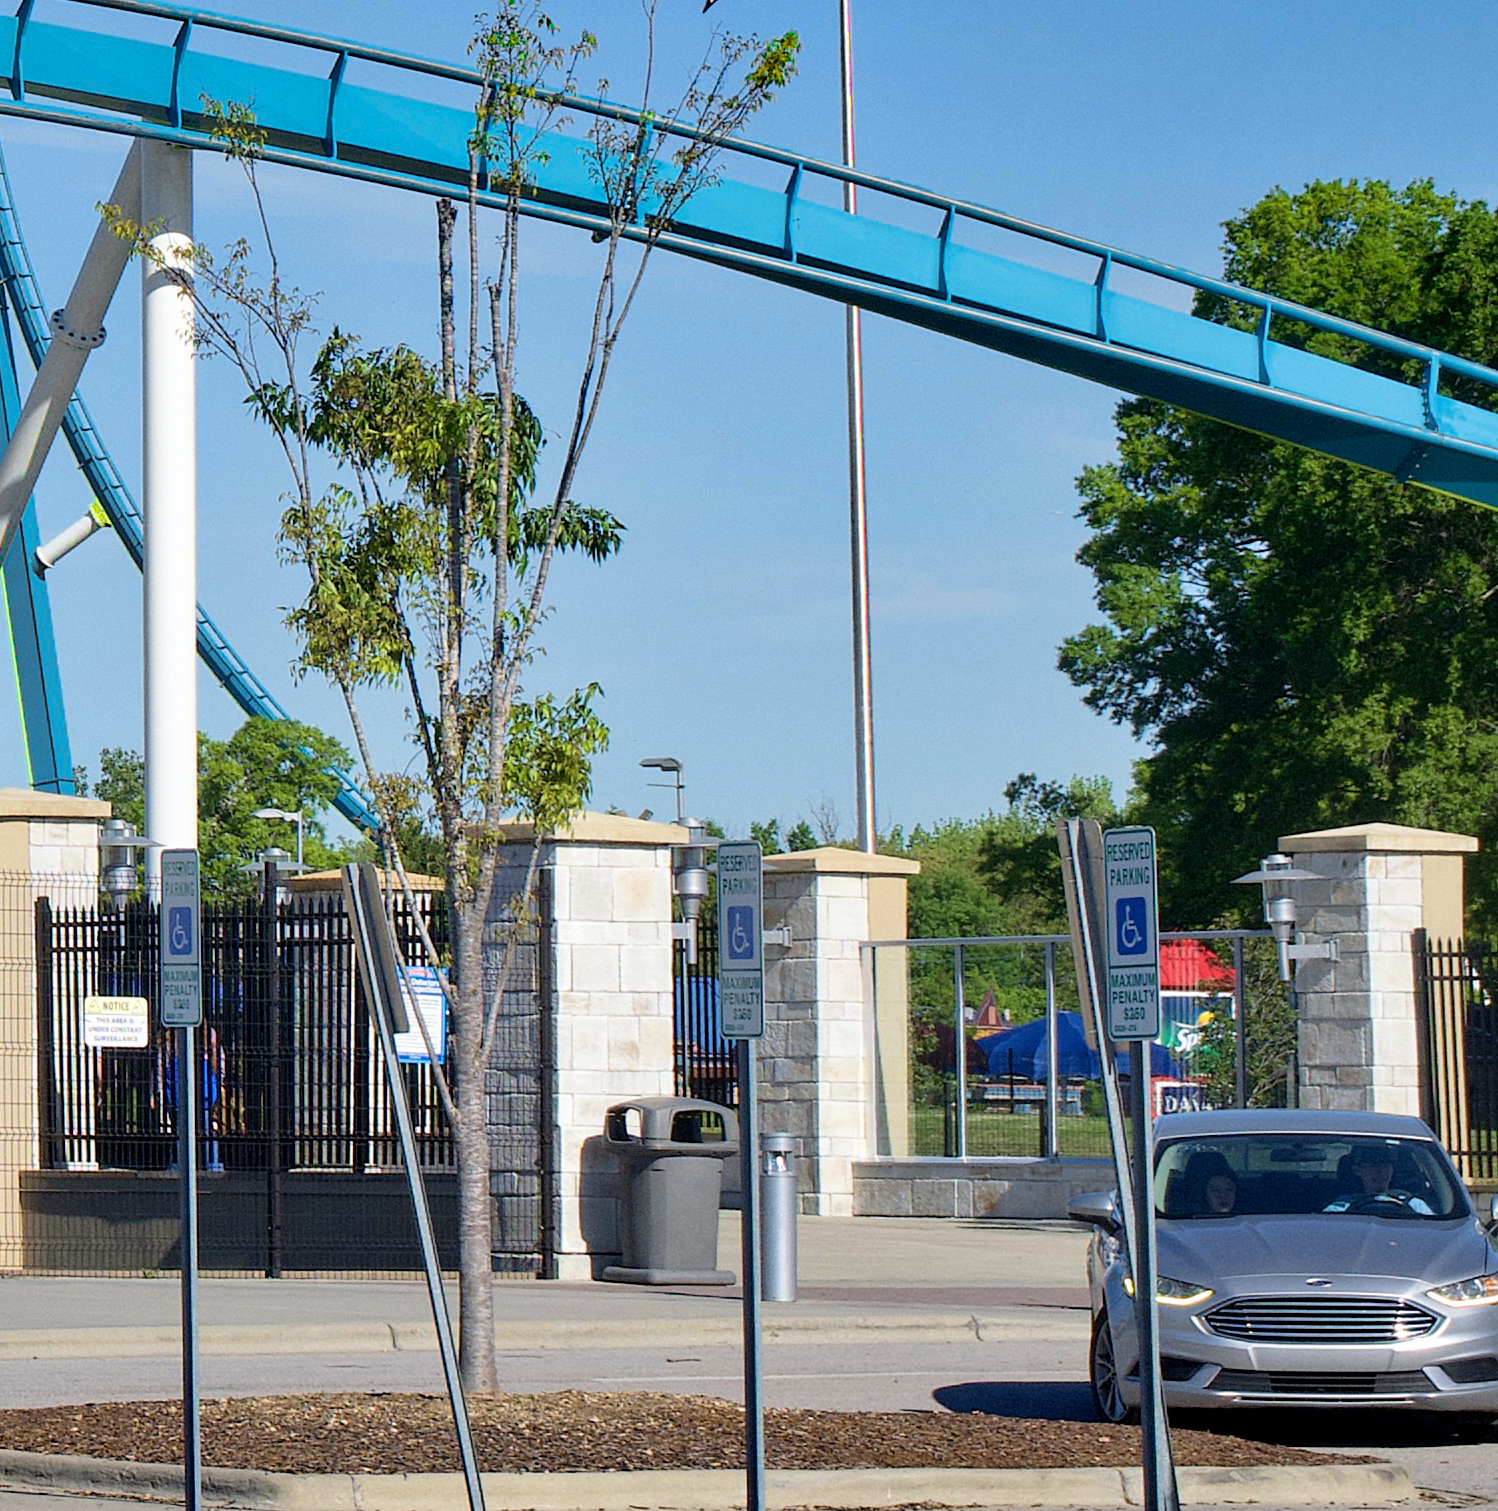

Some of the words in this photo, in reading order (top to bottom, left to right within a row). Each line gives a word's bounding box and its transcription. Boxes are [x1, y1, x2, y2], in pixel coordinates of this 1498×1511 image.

[1106, 842, 1150, 861] RESERVED
[164, 861, 195, 875] RESERVED
[721, 855, 757, 871] RESERVED
[1110, 867, 1150, 886] PARKING
[165, 882, 194, 896] PARKING
[723, 878, 757, 894] PARKING
[722, 976, 759, 988] MAXIMUM
[1109, 973, 1155, 987] MAXIMUM
[724, 992, 759, 1004] PENALTY
[1112, 990, 1154, 1004] PENALTY
[103, 1001, 129, 1011] NOTICE
[1124, 1007, 1145, 1020] $250
